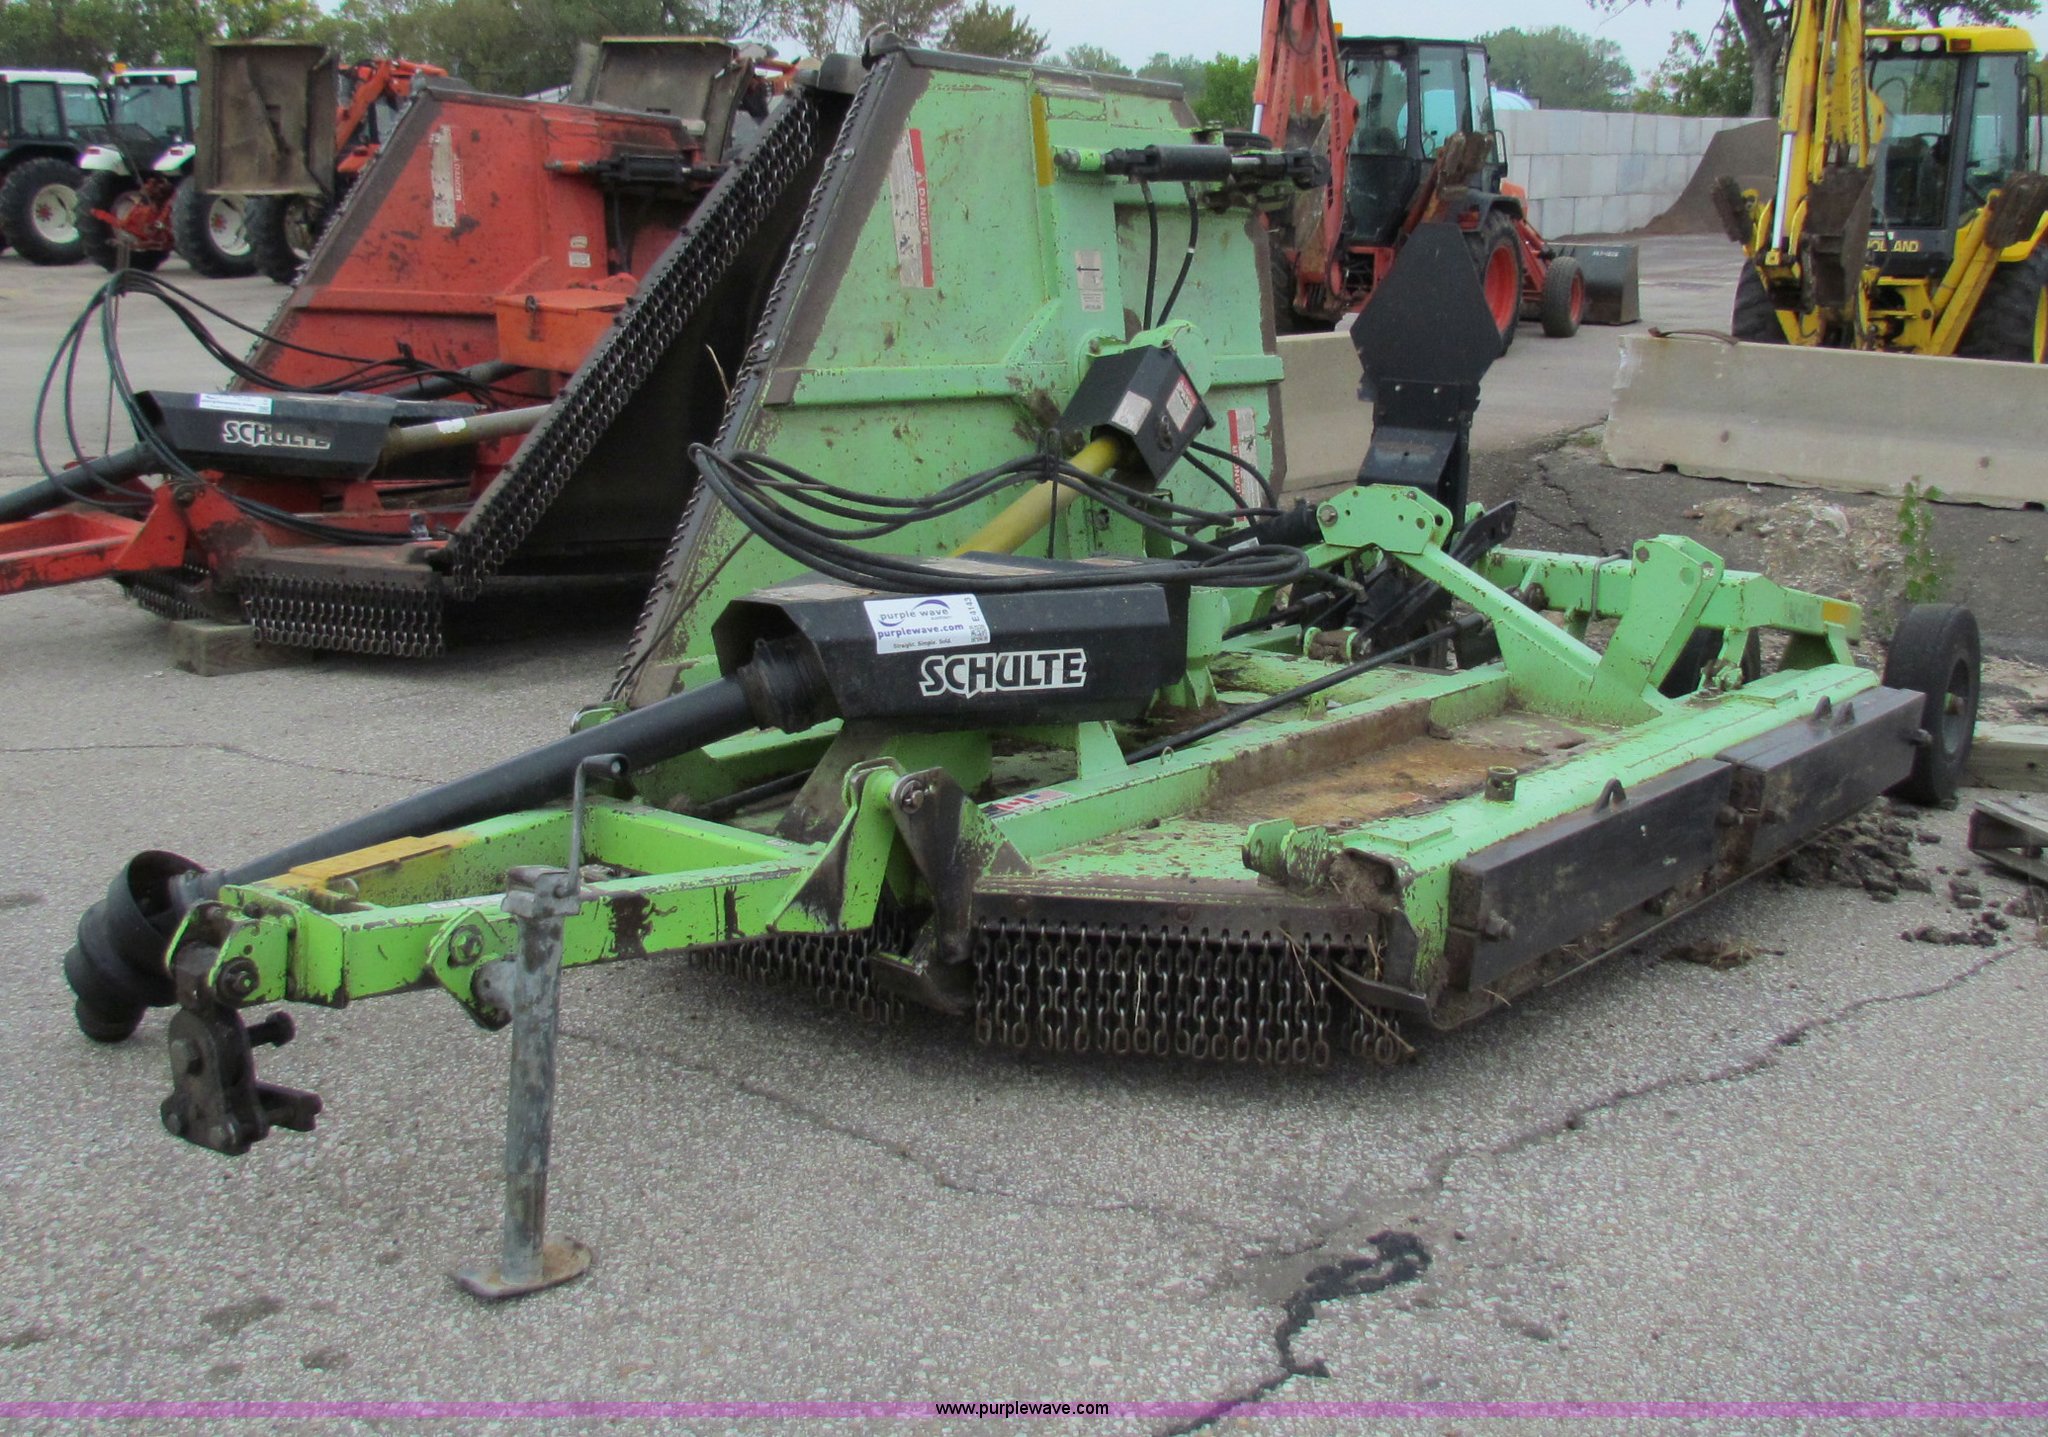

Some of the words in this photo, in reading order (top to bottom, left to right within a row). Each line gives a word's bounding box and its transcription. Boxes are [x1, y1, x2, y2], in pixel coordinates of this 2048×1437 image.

[918, 188, 928, 245] DANGER
[1866, 240, 1919, 252] OLAND
[880, 610, 917, 621] purple
[919, 608, 949, 617] wave
[877, 623, 964, 640] purplewave.com
[919, 648, 1087, 698] SCHULTE
